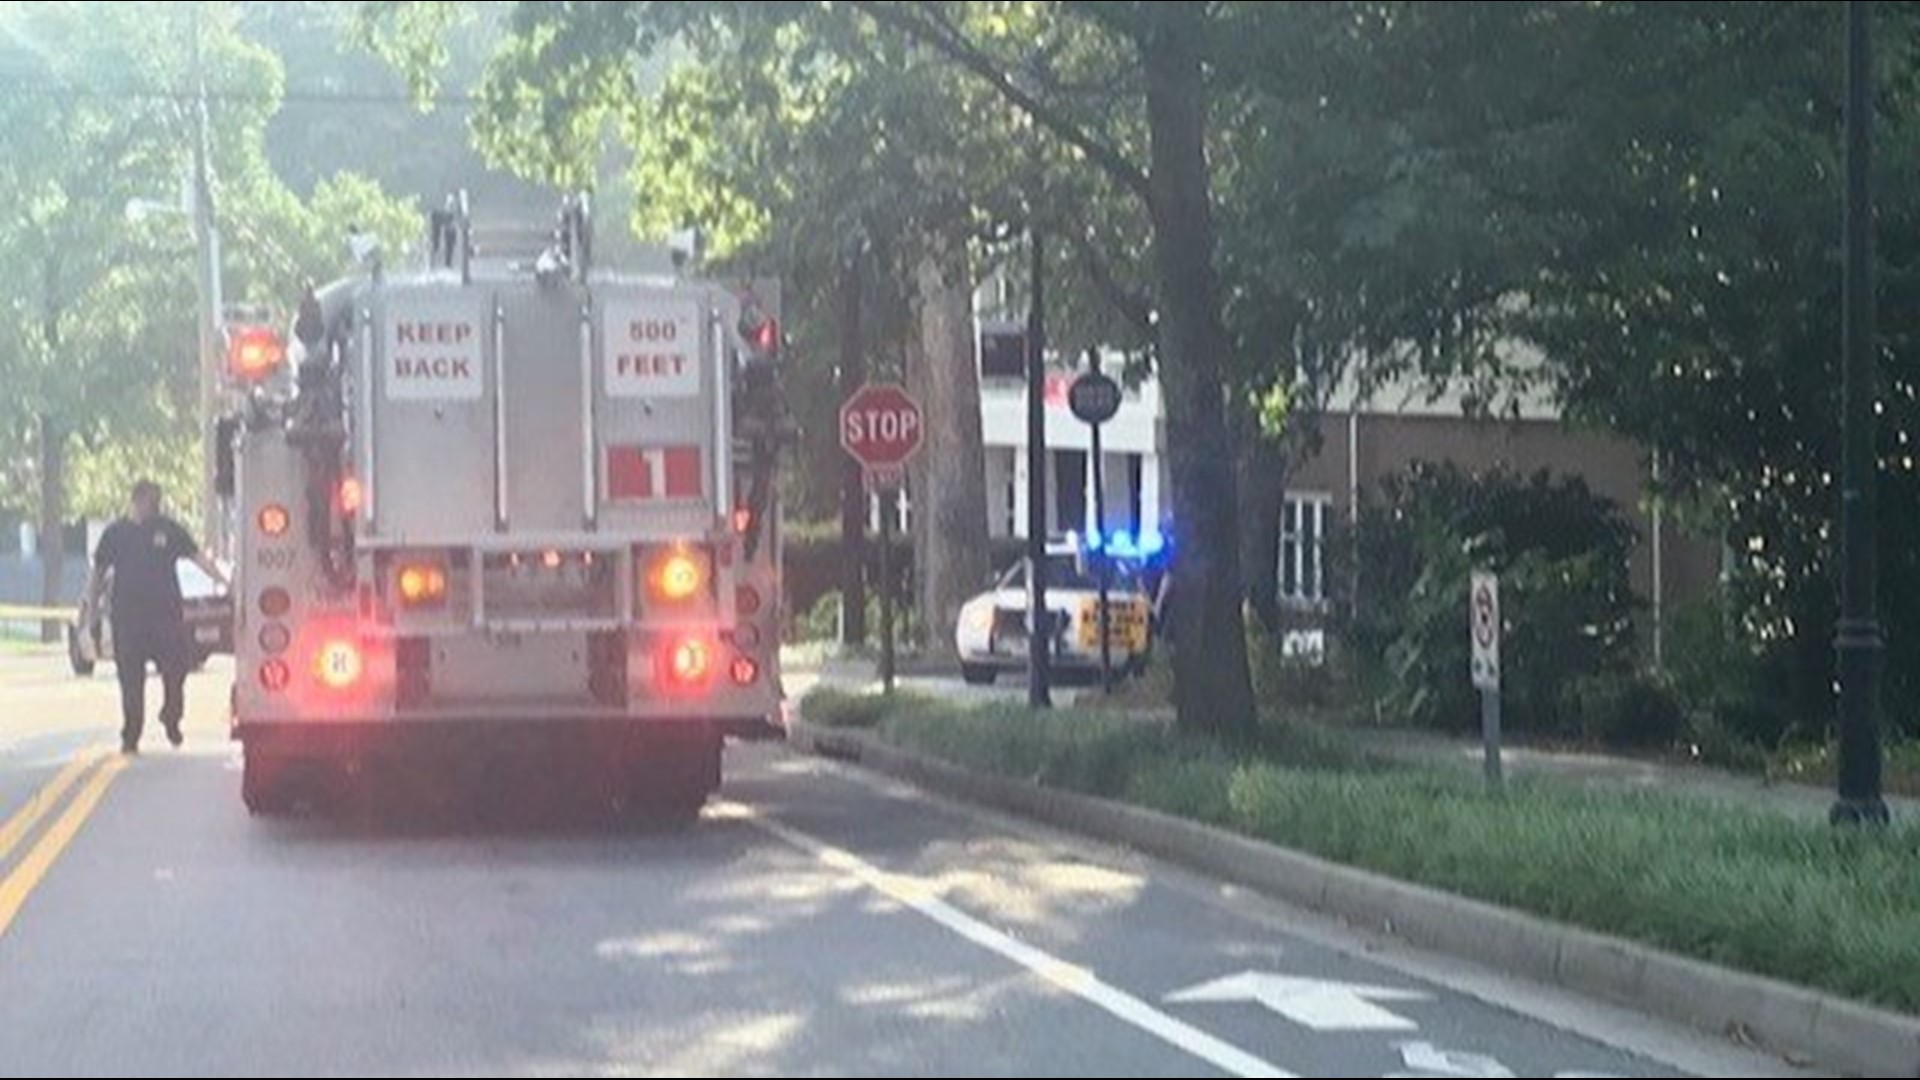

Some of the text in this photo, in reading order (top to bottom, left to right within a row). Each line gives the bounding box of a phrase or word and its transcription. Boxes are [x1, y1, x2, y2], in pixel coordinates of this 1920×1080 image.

[396, 322, 472, 343] KEEP
[629, 320, 677, 341] 500
[395, 358, 470, 379] BACK
[617, 355, 687, 376] FEET
[847, 409, 917, 443] STOP
[641, 449, 666, 499] 1
